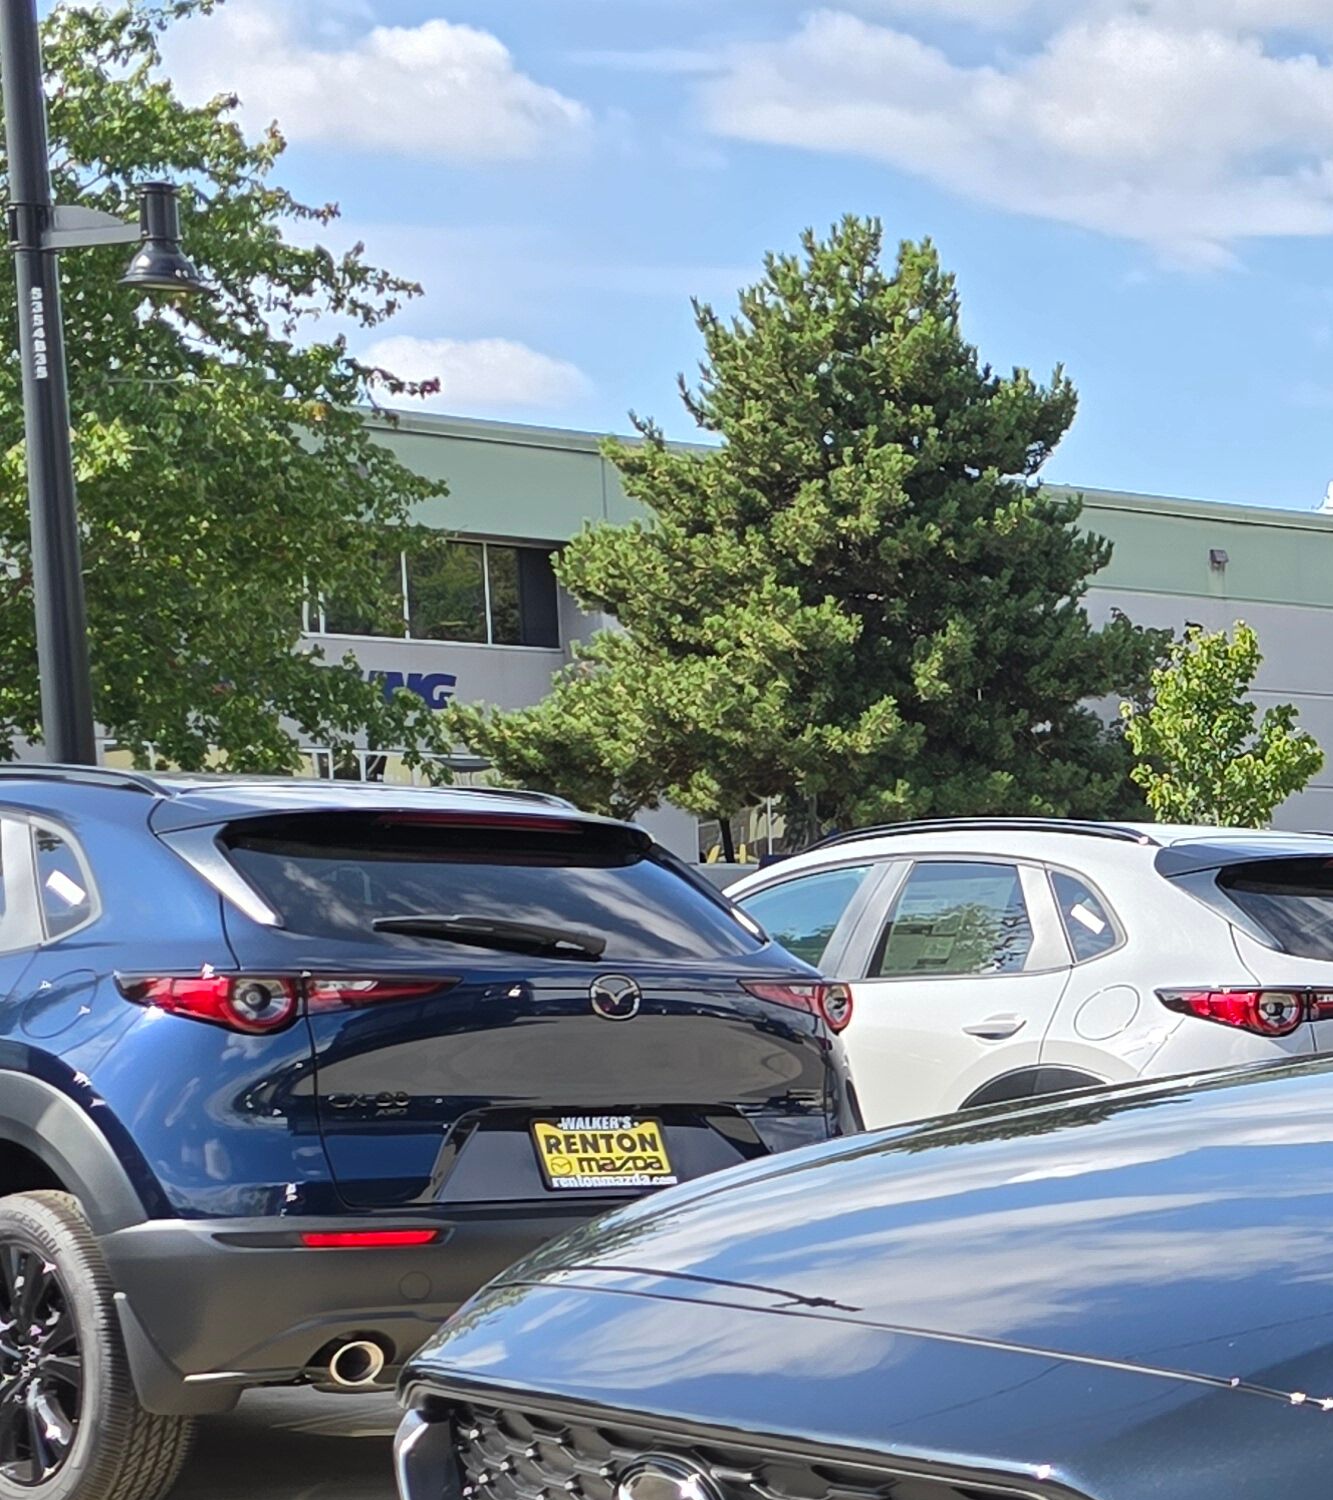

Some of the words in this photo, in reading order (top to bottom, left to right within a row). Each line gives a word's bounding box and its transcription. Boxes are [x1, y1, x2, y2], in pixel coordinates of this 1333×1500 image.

[560, 1115, 632, 1130] WALKER'S
[543, 1133, 659, 1155] RENTON
[552, 1173, 678, 1188] rentonmazda.com
